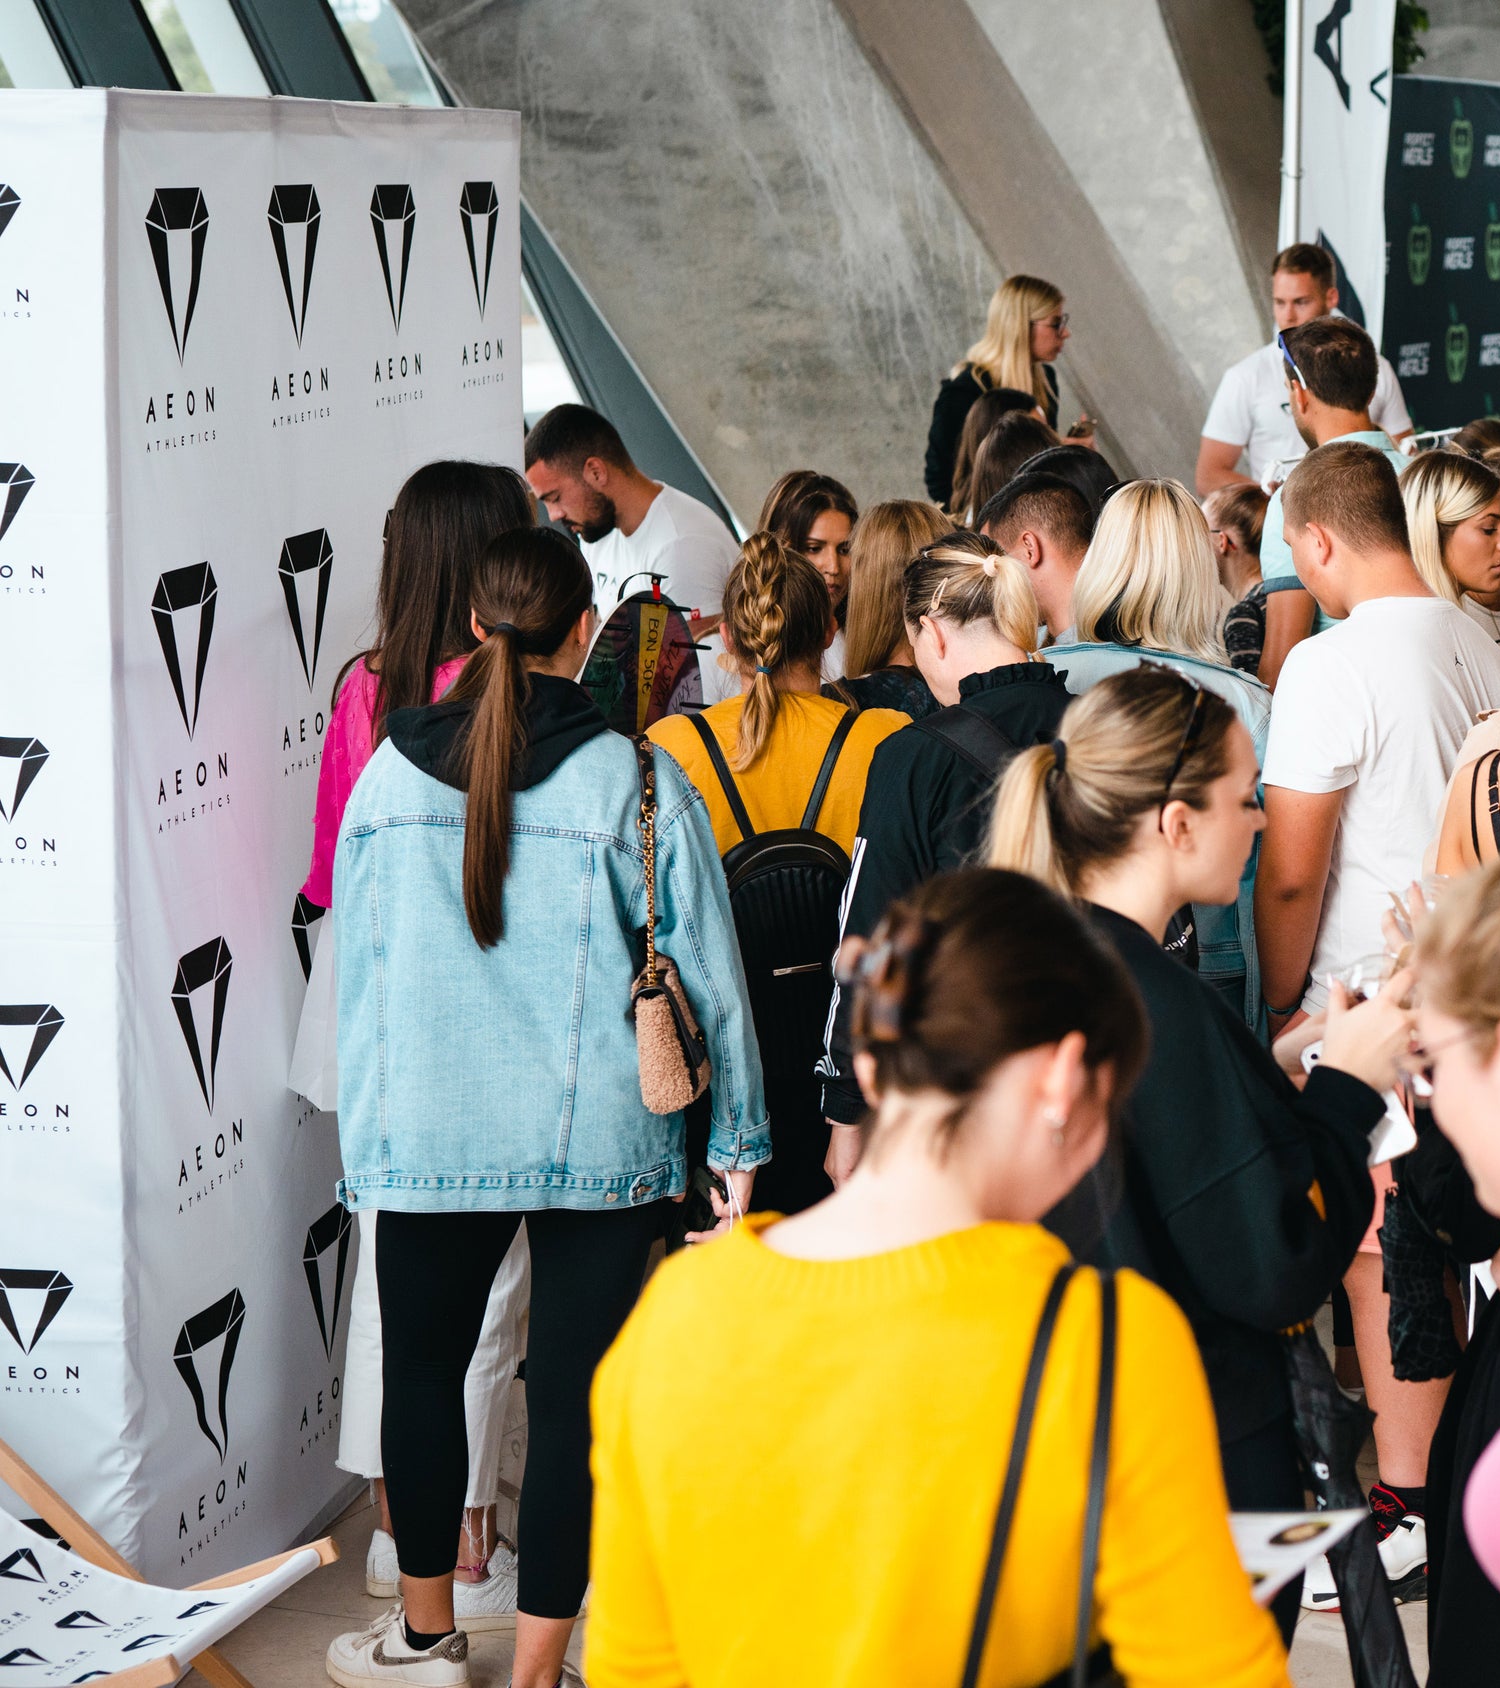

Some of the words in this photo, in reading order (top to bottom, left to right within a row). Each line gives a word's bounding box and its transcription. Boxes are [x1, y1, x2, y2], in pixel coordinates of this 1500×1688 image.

[374, 352, 422, 384] AEON
[461, 338, 503, 367] AEON
[271, 367, 329, 402] AEON
[375, 390, 424, 408] ATHLETICS
[145, 386, 215, 425] AEON
[272, 408, 330, 429] ATHLETICS
[146, 429, 217, 454] ATHLETICS
[0, 564, 45, 580] ON
[646, 618, 660, 652] BON
[282, 711, 325, 752] AEO
[157, 751, 229, 806] AEON
[158, 793, 231, 834] ATHLETICS
[15, 836, 56, 852] ON
[0, 857, 57, 867] LETICS
[0, 1102, 70, 1118] EON
[7, 1124, 70, 1132] LETICS
[178, 1118, 243, 1188] AEON
[178, 1158, 244, 1215] ATHLETICS
[8, 1365, 79, 1380] EON
[5, 1385, 81, 1394] HLETICS
[299, 1376, 340, 1432] AEO
[300, 1412, 339, 1457] ATHLET
[178, 1460, 247, 1540] AEON
[180, 1500, 247, 1567] ATHLETICS
